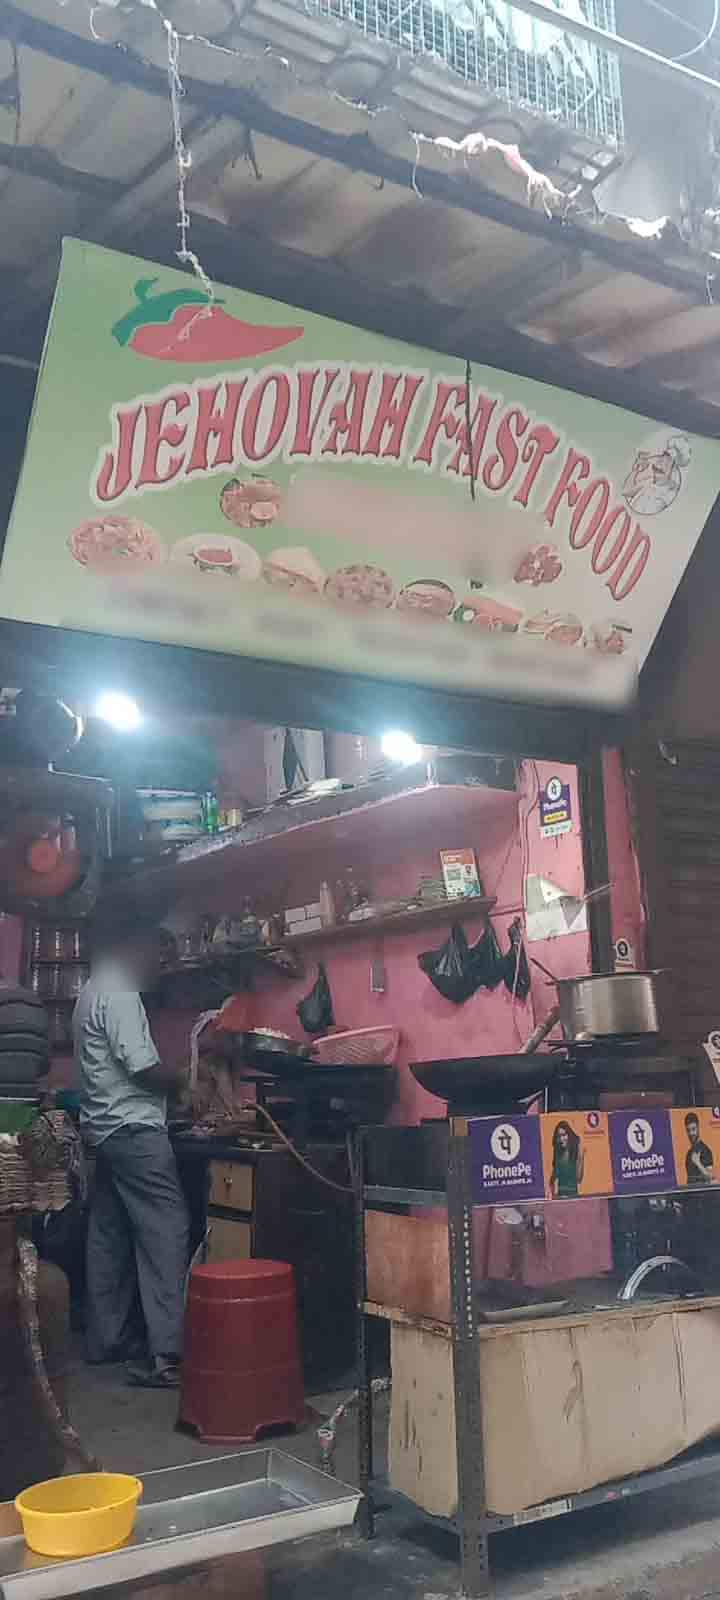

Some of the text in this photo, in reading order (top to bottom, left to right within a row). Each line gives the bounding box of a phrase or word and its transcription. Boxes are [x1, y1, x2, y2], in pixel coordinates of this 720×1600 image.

[97, 368, 424, 501] JEHOVAH
[413, 383, 560, 507] FAST
[544, 447, 651, 601] FOOD
[482, 1162, 532, 1179] PhonePe
[621, 1154, 665, 1171] PhonePe
